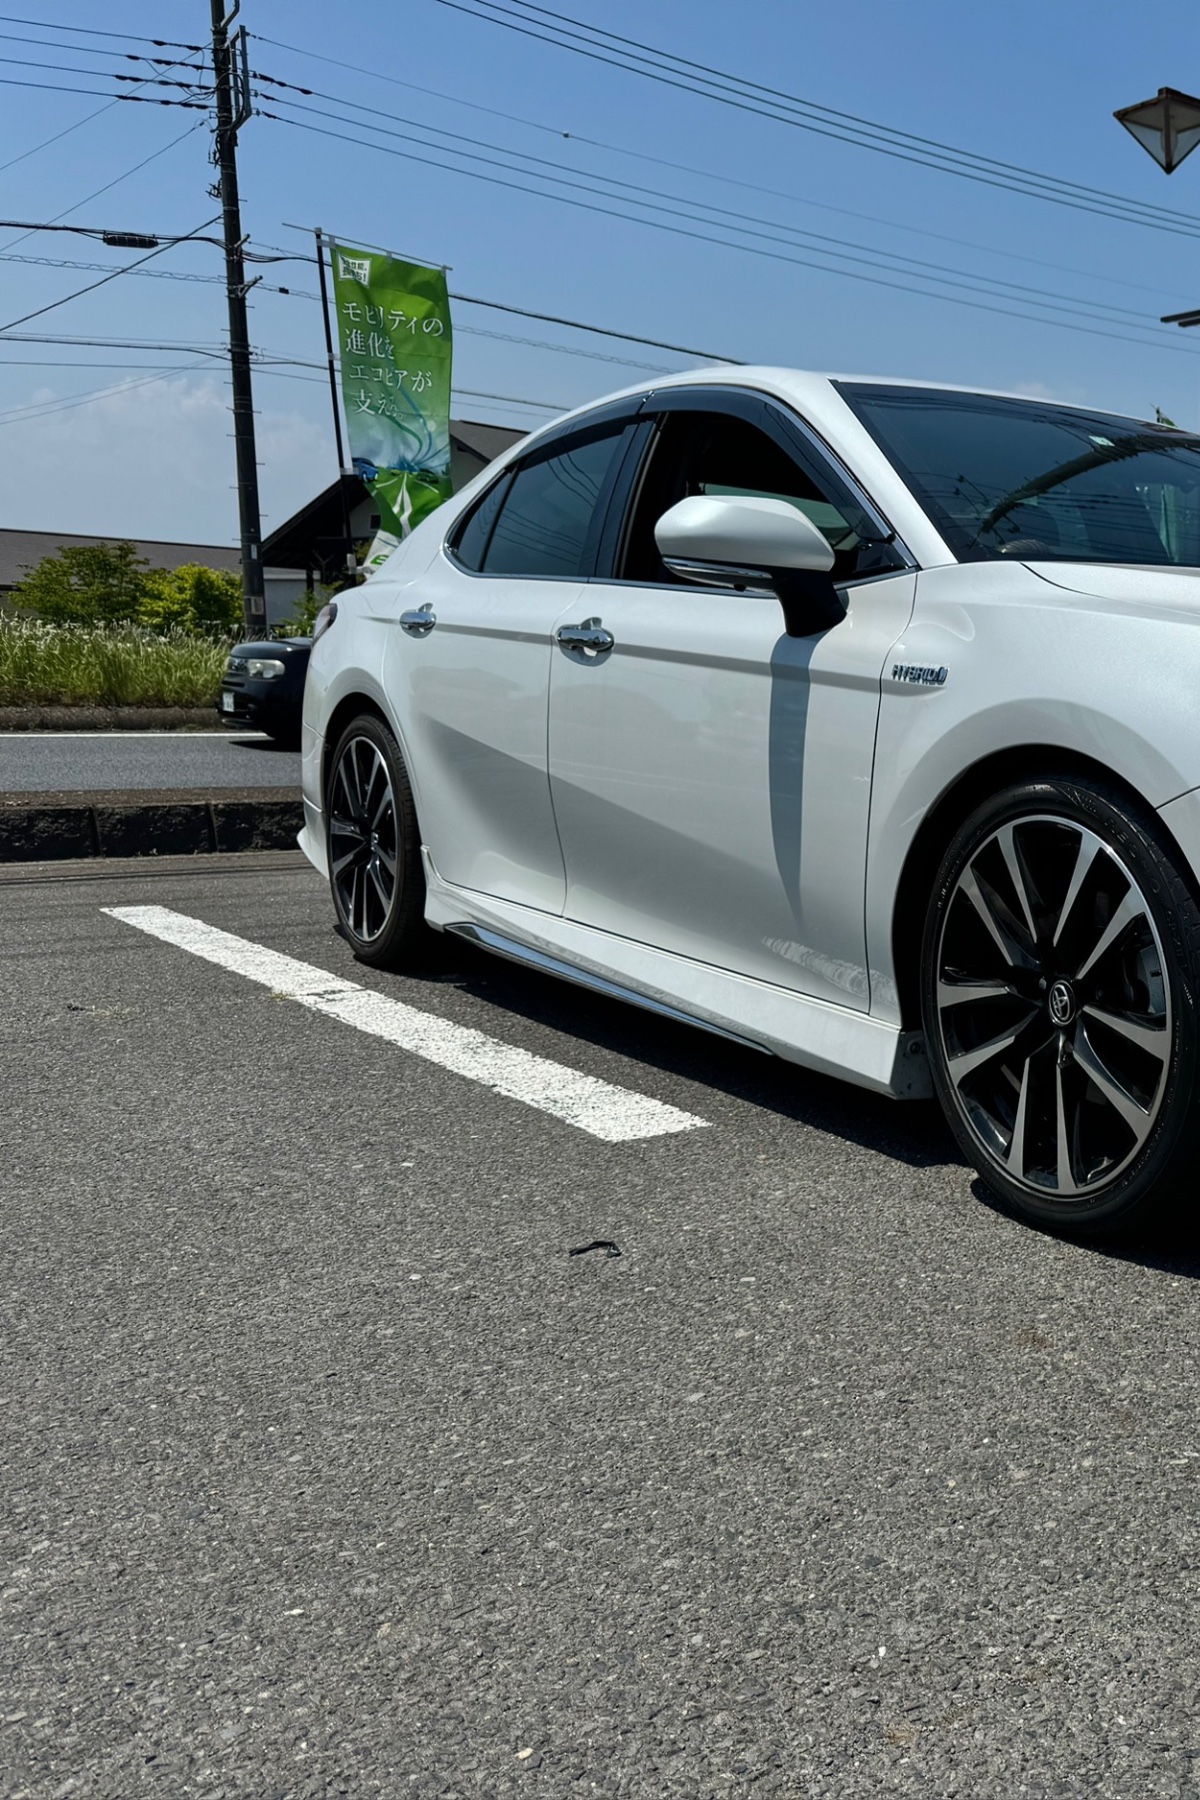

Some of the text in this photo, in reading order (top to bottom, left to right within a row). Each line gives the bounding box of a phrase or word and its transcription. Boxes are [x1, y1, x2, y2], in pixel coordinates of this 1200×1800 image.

[342, 302, 444, 337] モビリティの
[345, 328, 394, 360] 進化を
[892, 664, 937, 682] HYBRID
